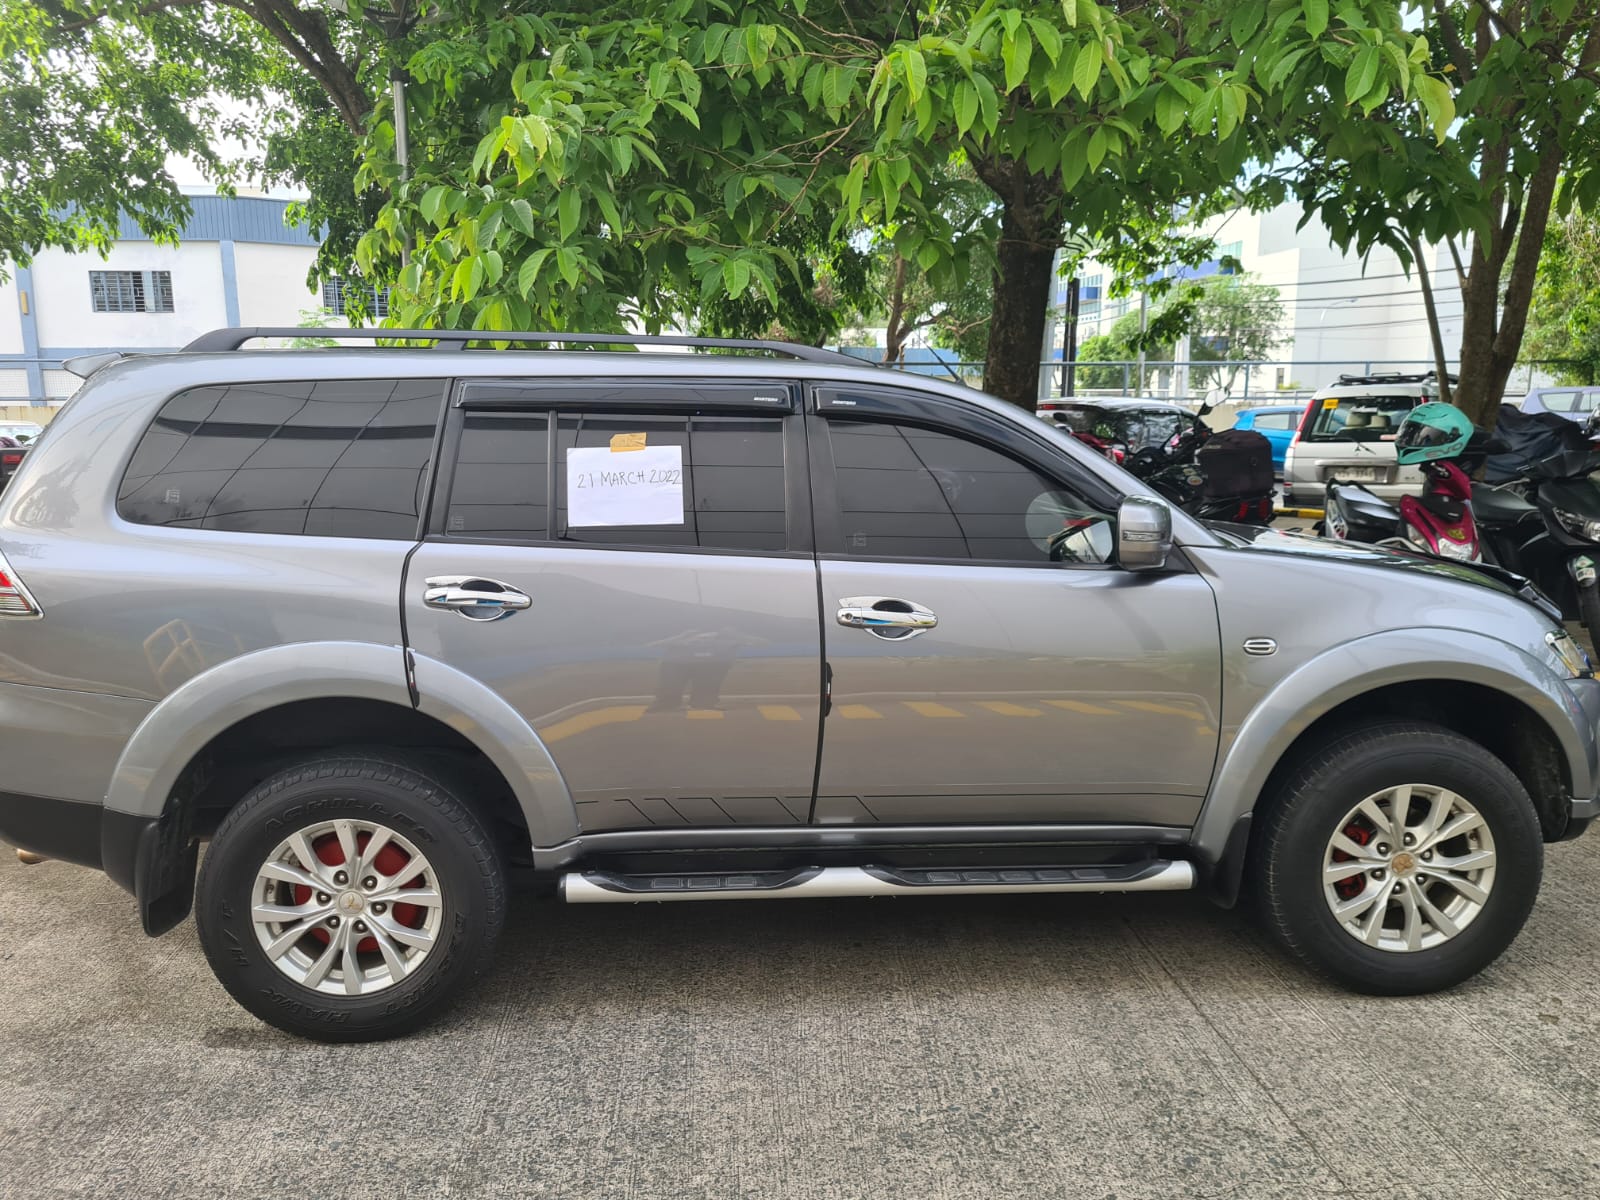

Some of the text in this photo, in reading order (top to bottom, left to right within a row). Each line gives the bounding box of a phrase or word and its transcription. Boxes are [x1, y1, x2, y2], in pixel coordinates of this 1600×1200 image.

[1425, 442, 1463, 459] EVO
[577, 469, 682, 489] 21 MARCH 2022
